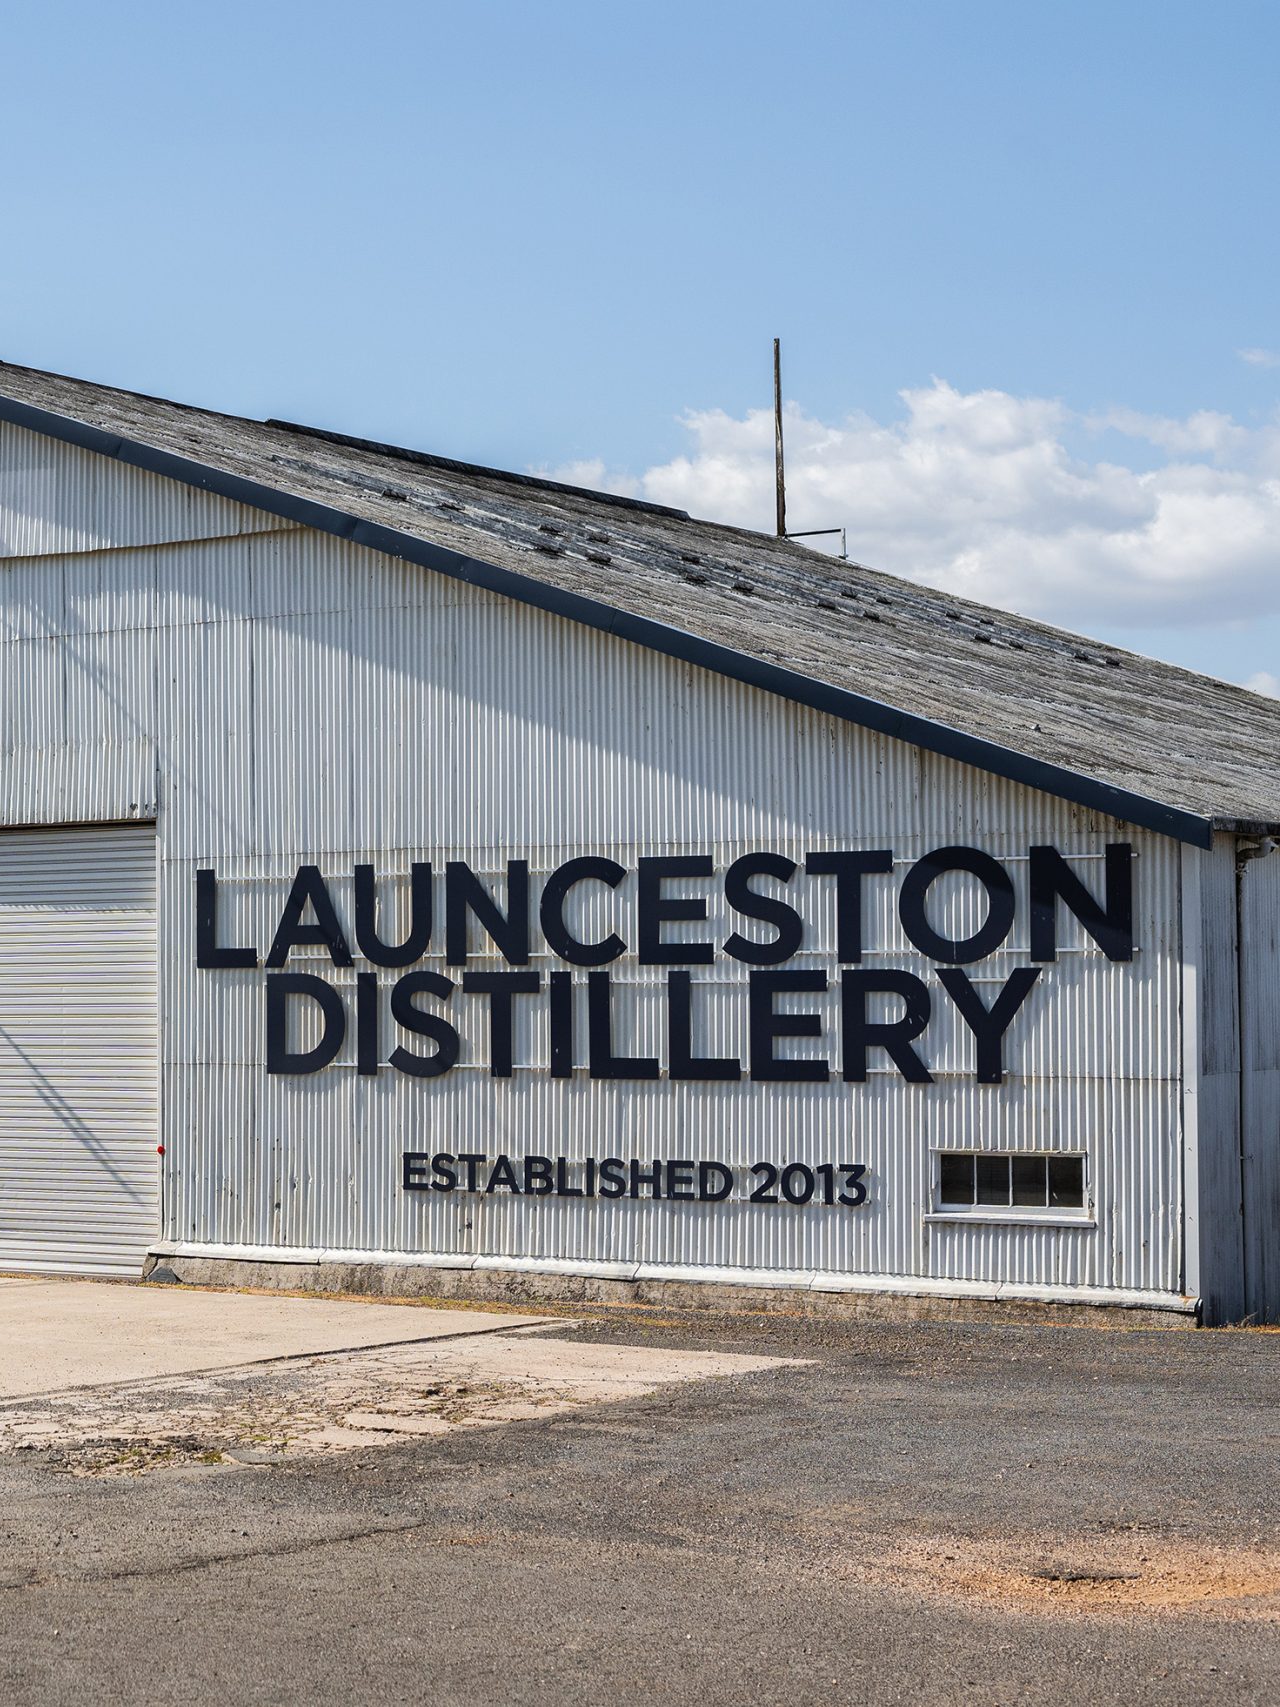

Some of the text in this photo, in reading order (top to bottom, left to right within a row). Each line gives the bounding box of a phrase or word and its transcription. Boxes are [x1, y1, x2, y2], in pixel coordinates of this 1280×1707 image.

[196, 843, 1133, 969] LAUNCESTON
[266, 967, 1043, 1084] DISTILLERY
[402, 1152, 867, 1206] ESTABLISHED 2013
